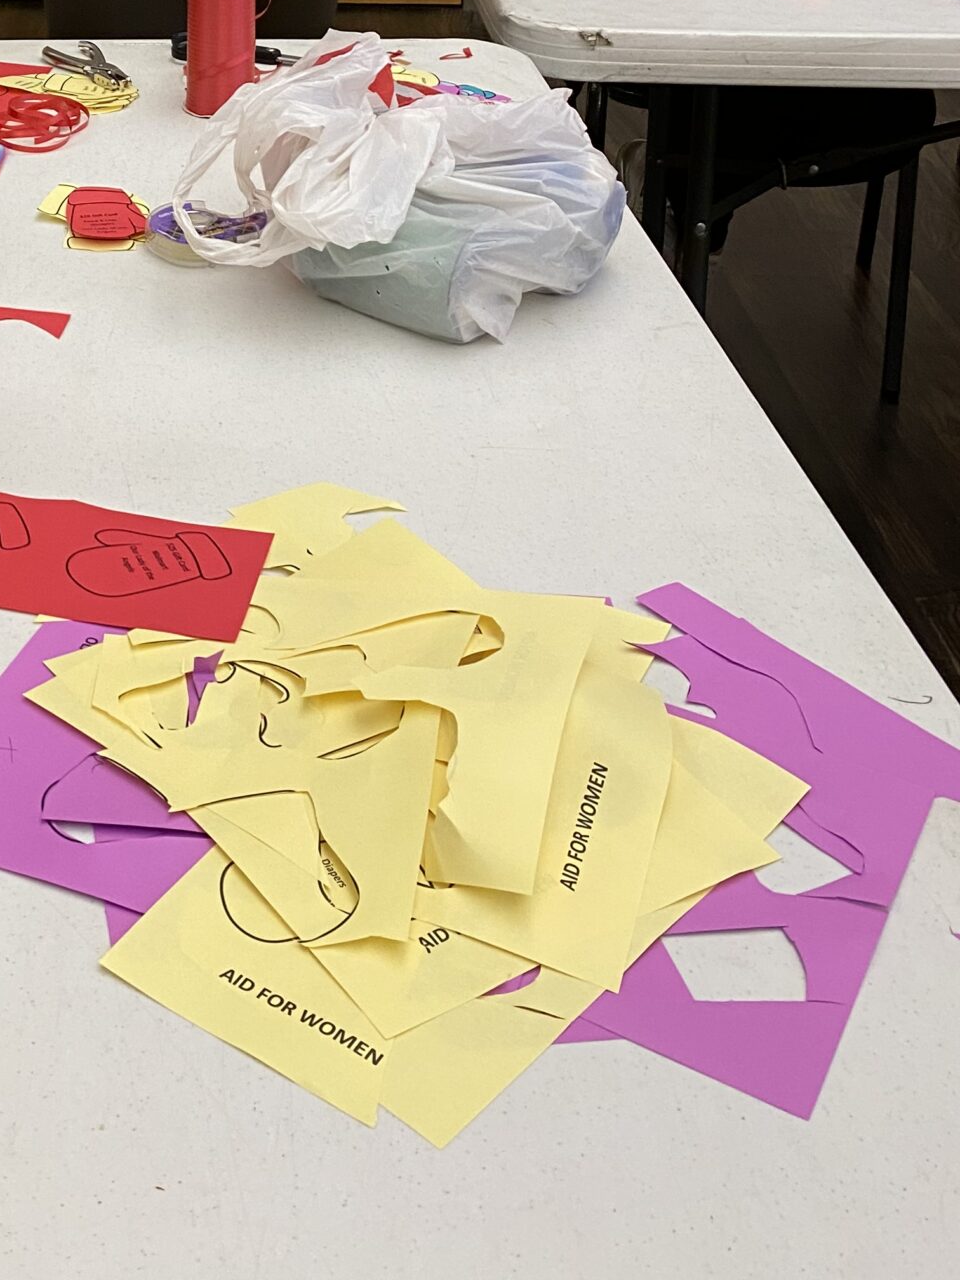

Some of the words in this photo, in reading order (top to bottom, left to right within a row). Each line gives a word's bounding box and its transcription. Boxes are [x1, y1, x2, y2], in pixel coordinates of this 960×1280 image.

[575, 761, 609, 830] WOMEN
[567, 831, 590, 862] FOR
[321, 858, 347, 888] Diapers
[559, 862, 581, 892] AID
[418, 928, 450, 954] AID
[219, 968, 256, 993] AID
[256, 987, 297, 1016] FOR
[299, 1009, 384, 1066] WOMEN
